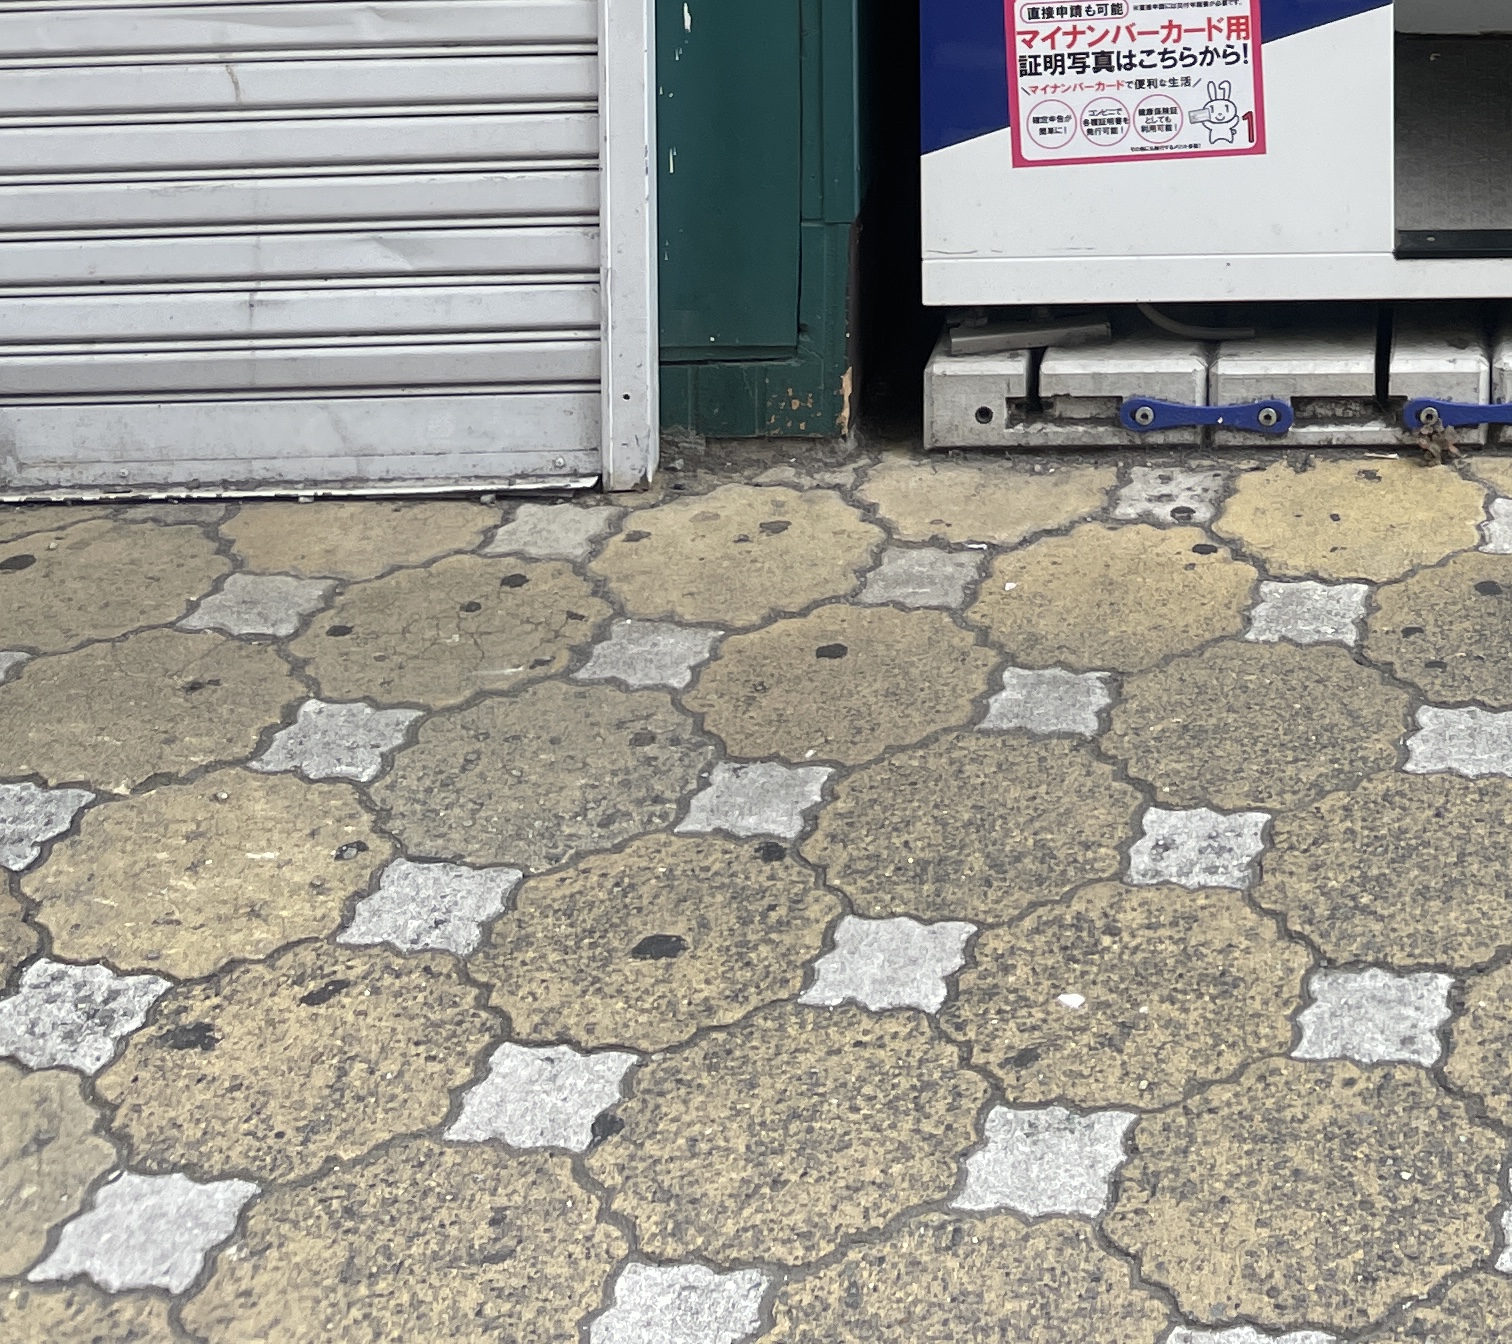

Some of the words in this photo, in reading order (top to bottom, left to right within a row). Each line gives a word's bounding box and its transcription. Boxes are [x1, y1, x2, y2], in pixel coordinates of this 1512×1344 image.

[1027, 2, 1125, 21] 直接申請も可能
[1016, 15, 1251, 52] マイナンバーカード用
[1018, 42, 1250, 78] 証明写真はこちらから!
[1028, 75, 1194, 96] マイナンバーカードで便利な生活
